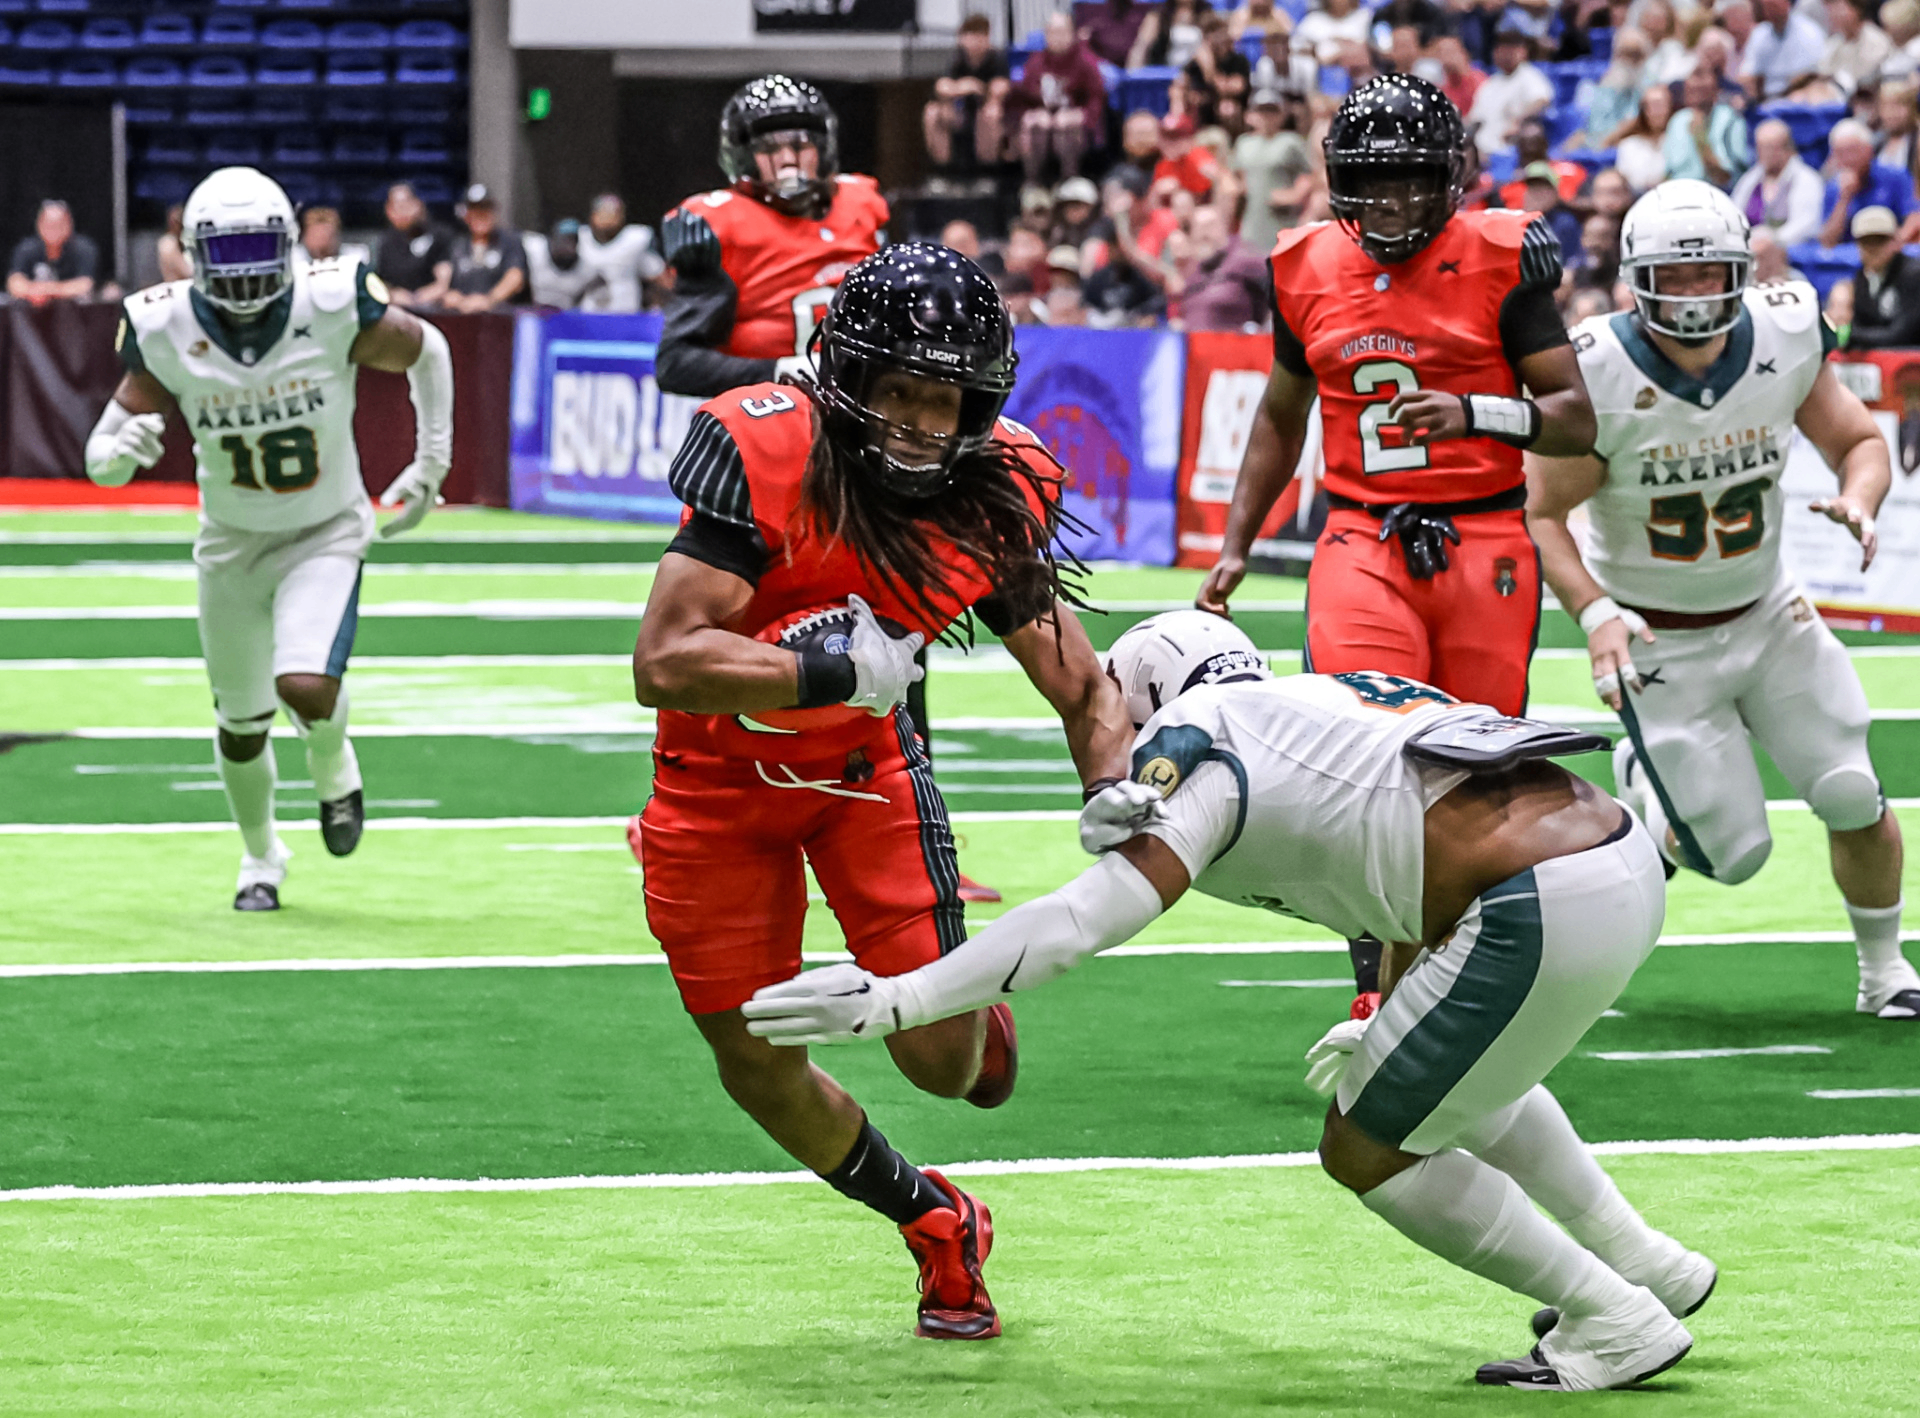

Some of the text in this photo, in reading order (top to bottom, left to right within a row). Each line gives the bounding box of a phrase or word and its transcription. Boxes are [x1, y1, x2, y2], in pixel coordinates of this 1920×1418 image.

[925, 348, 961, 364] LIGHT
[1340, 333, 1417, 360] WISEGUYS
[197, 386, 325, 429] AXEMEN
[551, 370, 638, 479] BUD
[739, 390, 796, 420] 3
[1352, 359, 1430, 476] 2
[220, 425, 321, 494] 18
[1640, 435, 1780, 487] AXEMEN
